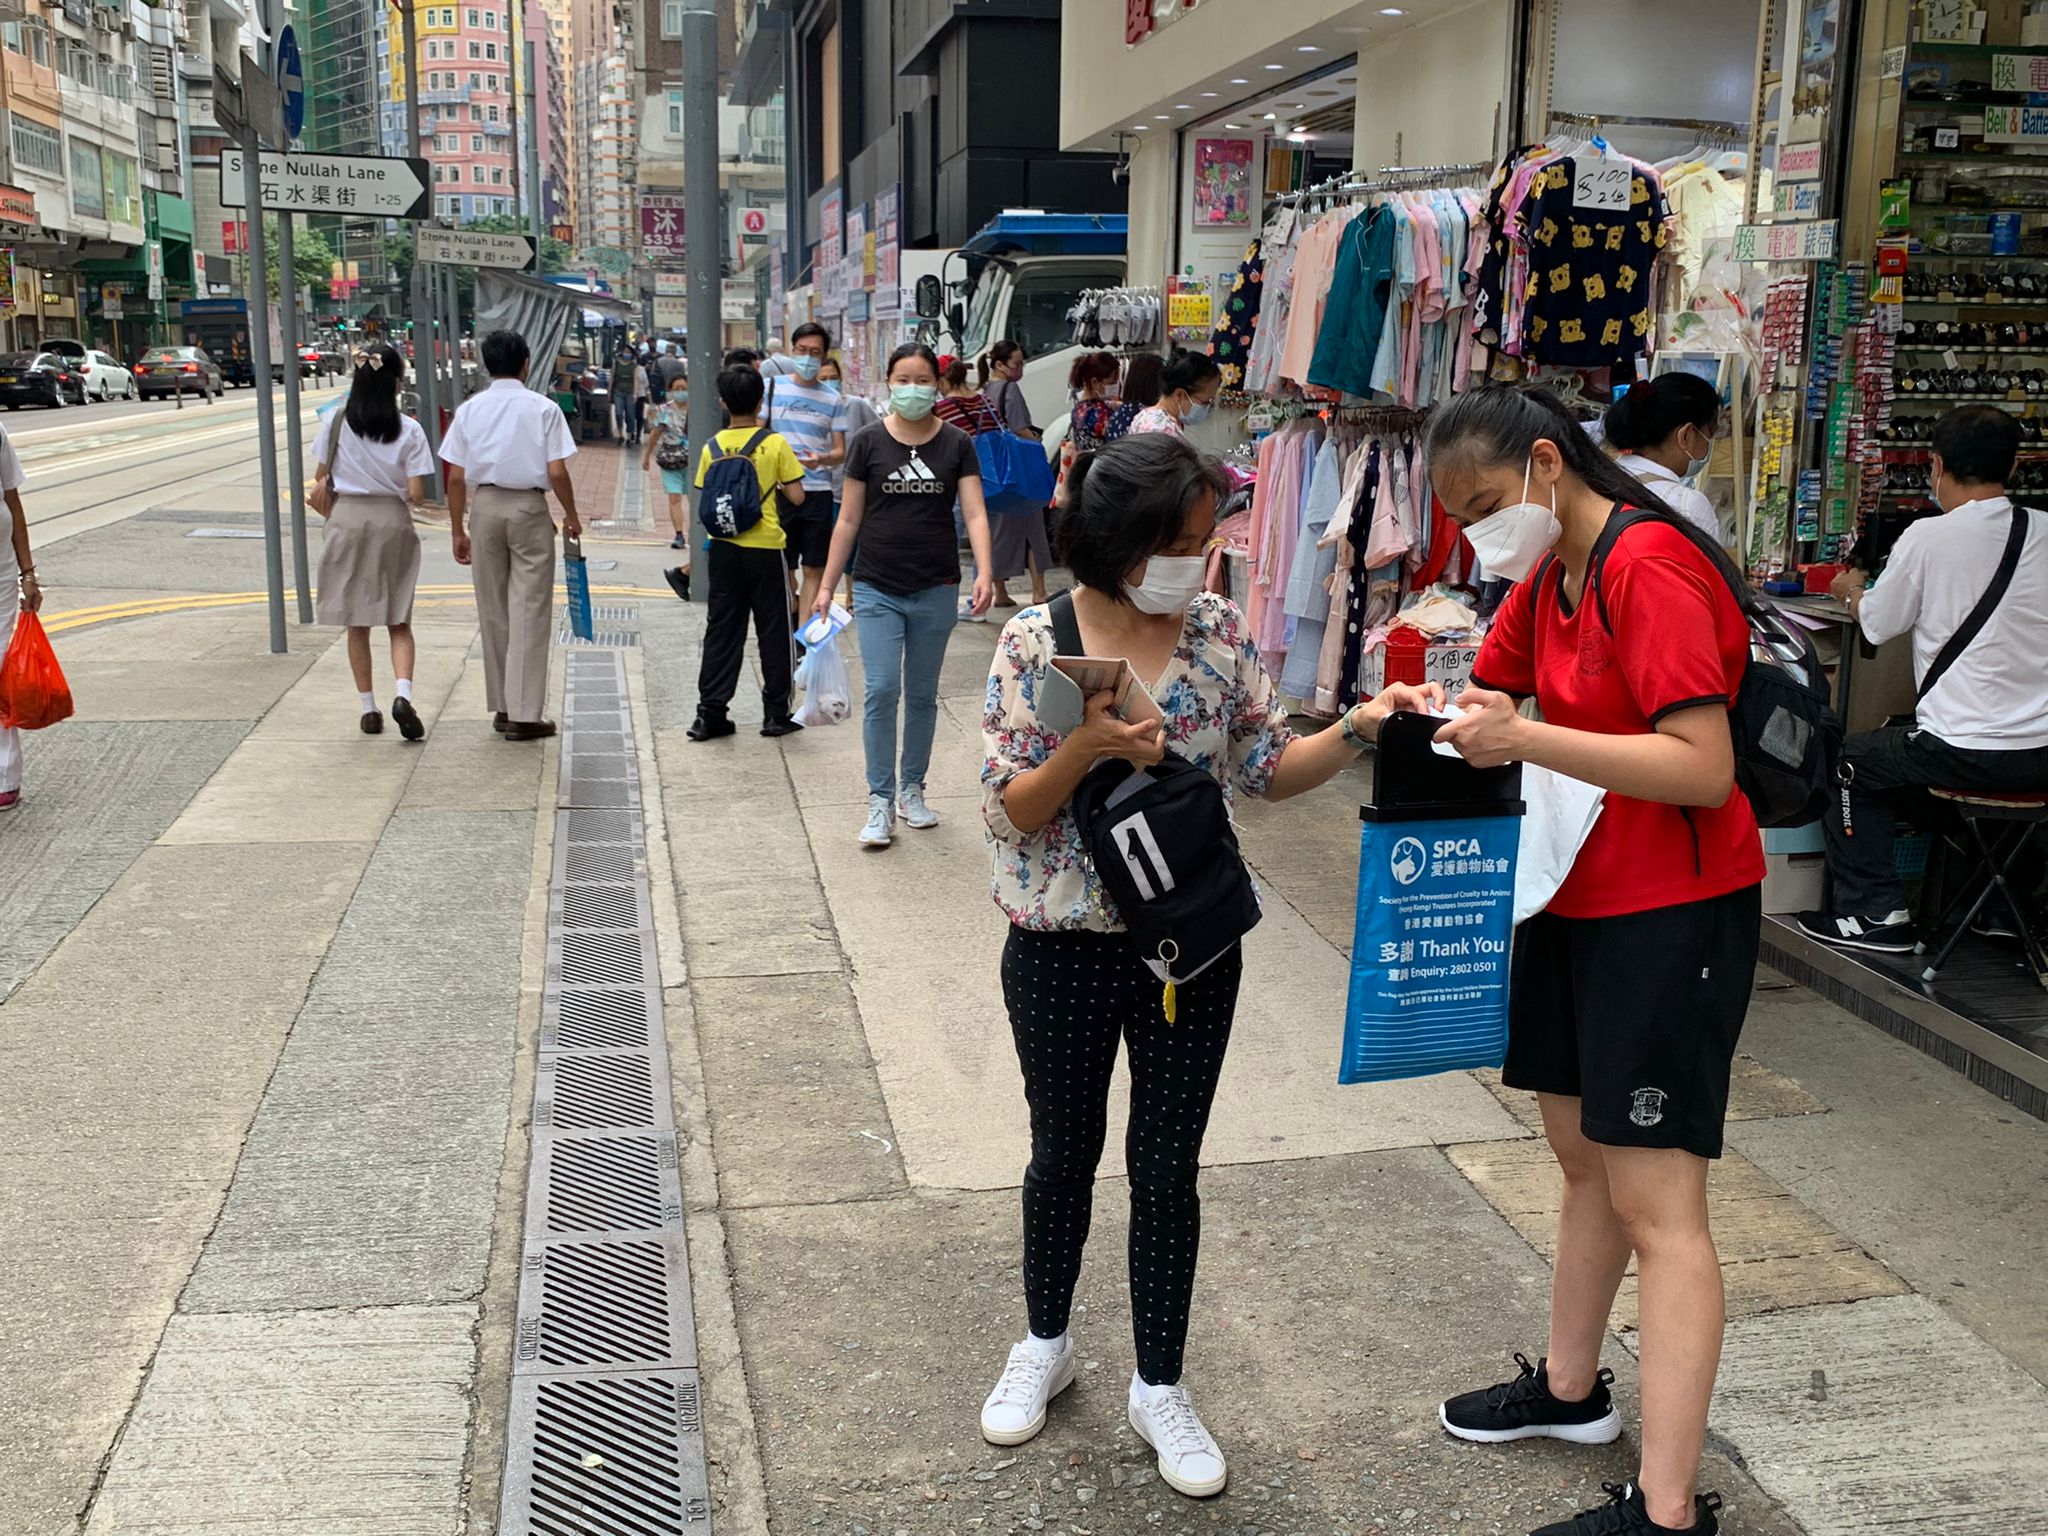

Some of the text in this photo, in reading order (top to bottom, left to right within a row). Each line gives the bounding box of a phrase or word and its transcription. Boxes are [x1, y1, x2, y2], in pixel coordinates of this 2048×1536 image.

[1994, 56, 2017, 90] 換
[1986, 107, 2007, 133] Belt
[2009, 107, 2018, 135] &
[231, 158, 385, 181] Sne Nullah Lane
[1779, 147, 1819, 177] Replacement
[261, 183, 356, 207] 石水渠街
[1776, 187, 1787, 212] Belt
[653, 209, 678, 234] 沐
[420, 231, 516, 248] Stone Nullah Lane
[1735, 228, 1756, 259] 換
[1767, 226, 1798, 258] 電池
[440, 247, 496, 262] 石水渠街
[881, 479, 944, 494] adidas
[1841, 788, 1850, 807] JUST
[1842, 807, 1851, 819] DO
[1432, 838, 1482, 859] SPCA
[1430, 857, 1510, 878] 愛護動物協會
[1378, 895, 1401, 905] Society
[1419, 892, 1453, 901] Prevention
[1459, 890, 1480, 900] Cruelty
[1457, 898, 1497, 909] Incorporated
[1378, 936, 1505, 963] 多謝 Thank You
[1411, 965, 1449, 979] Enquiry:
[1450, 963, 1472, 975] 2802
[1473, 961, 1497, 973] 0501
